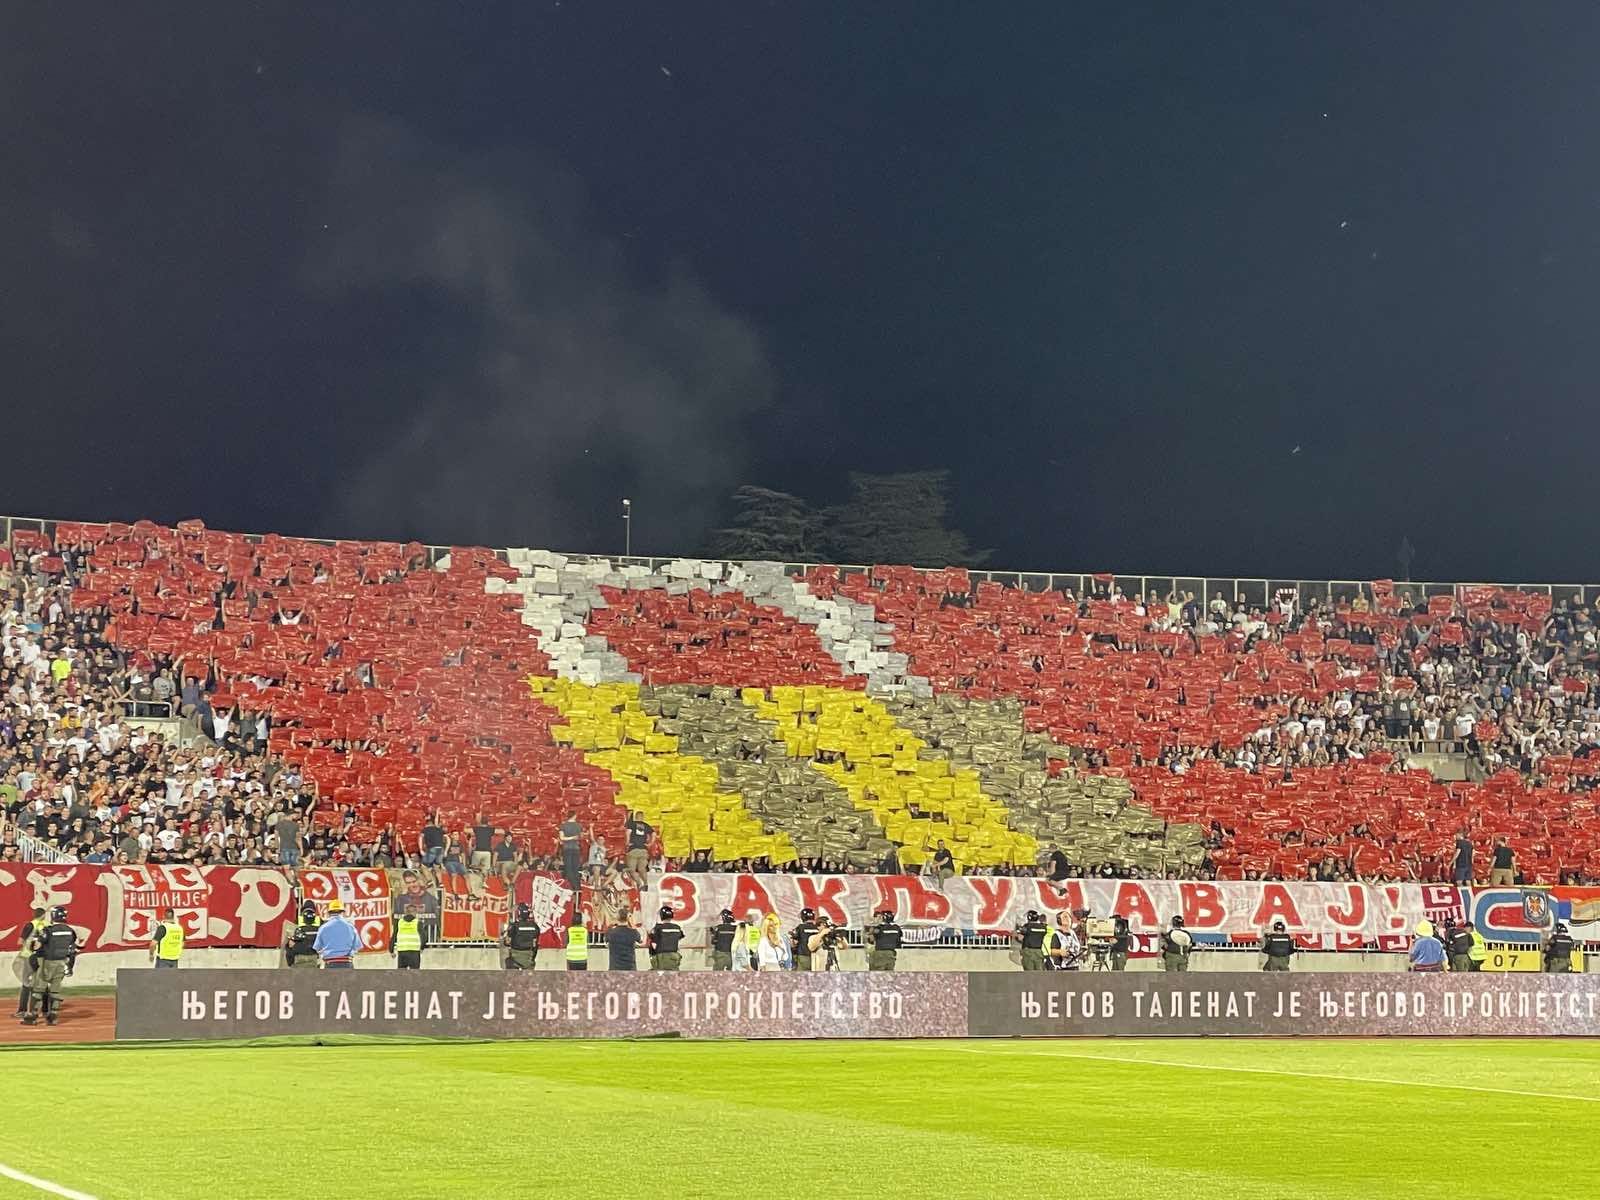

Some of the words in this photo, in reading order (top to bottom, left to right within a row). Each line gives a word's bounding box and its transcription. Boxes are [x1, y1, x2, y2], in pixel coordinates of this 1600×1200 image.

[658, 874, 1407, 929] ЗАКЉУЧАВАЈ!
[181, 990, 294, 1020] ЊЕГОВ
[315, 990, 463, 1020] ТАЛЕНАТ
[482, 991, 516, 1020] ЈЕ
[537, 991, 662, 1020] ЊЕГОВО
[684, 991, 903, 1020] ПРОКЛЕТСТВО
[1021, 990, 1114, 1018] ЊЕГОВ
[1132, 990, 1257, 1018] ТАЛЕНАТ
[1273, 991, 1301, 1018] ЈЕ
[1319, 990, 1426, 1018] ЊЕГОВО
